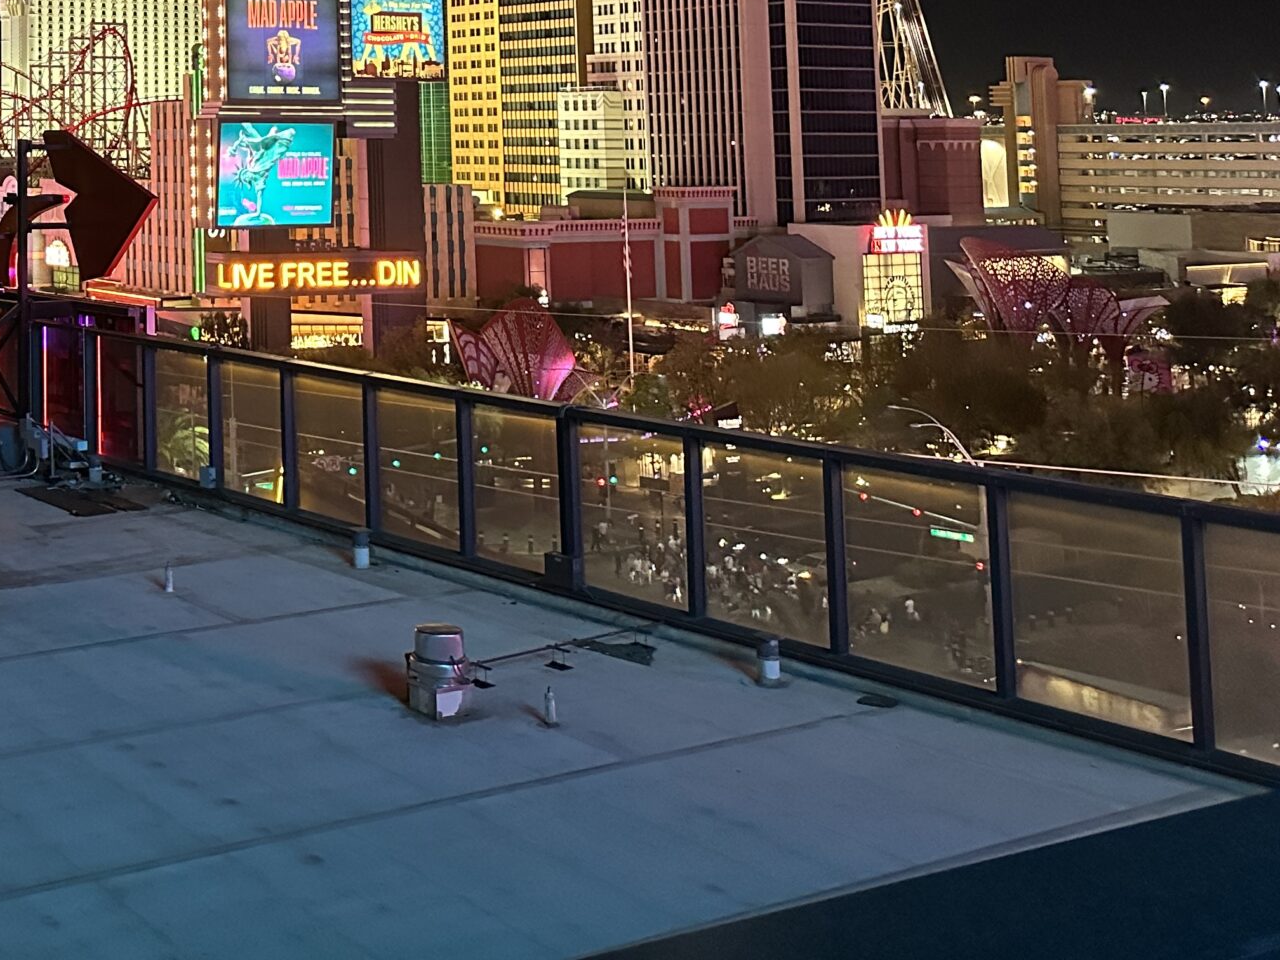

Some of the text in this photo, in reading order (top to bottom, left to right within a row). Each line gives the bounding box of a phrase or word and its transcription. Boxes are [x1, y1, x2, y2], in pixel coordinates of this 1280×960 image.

[279, 0, 318, 30] APPLE
[373, 15, 419, 31] HERSHEY'S
[301, 157, 329, 179] APPLE
[217, 261, 275, 289] LIVE
[746, 256, 790, 275] BEER
[747, 273, 790, 292] HAUS
